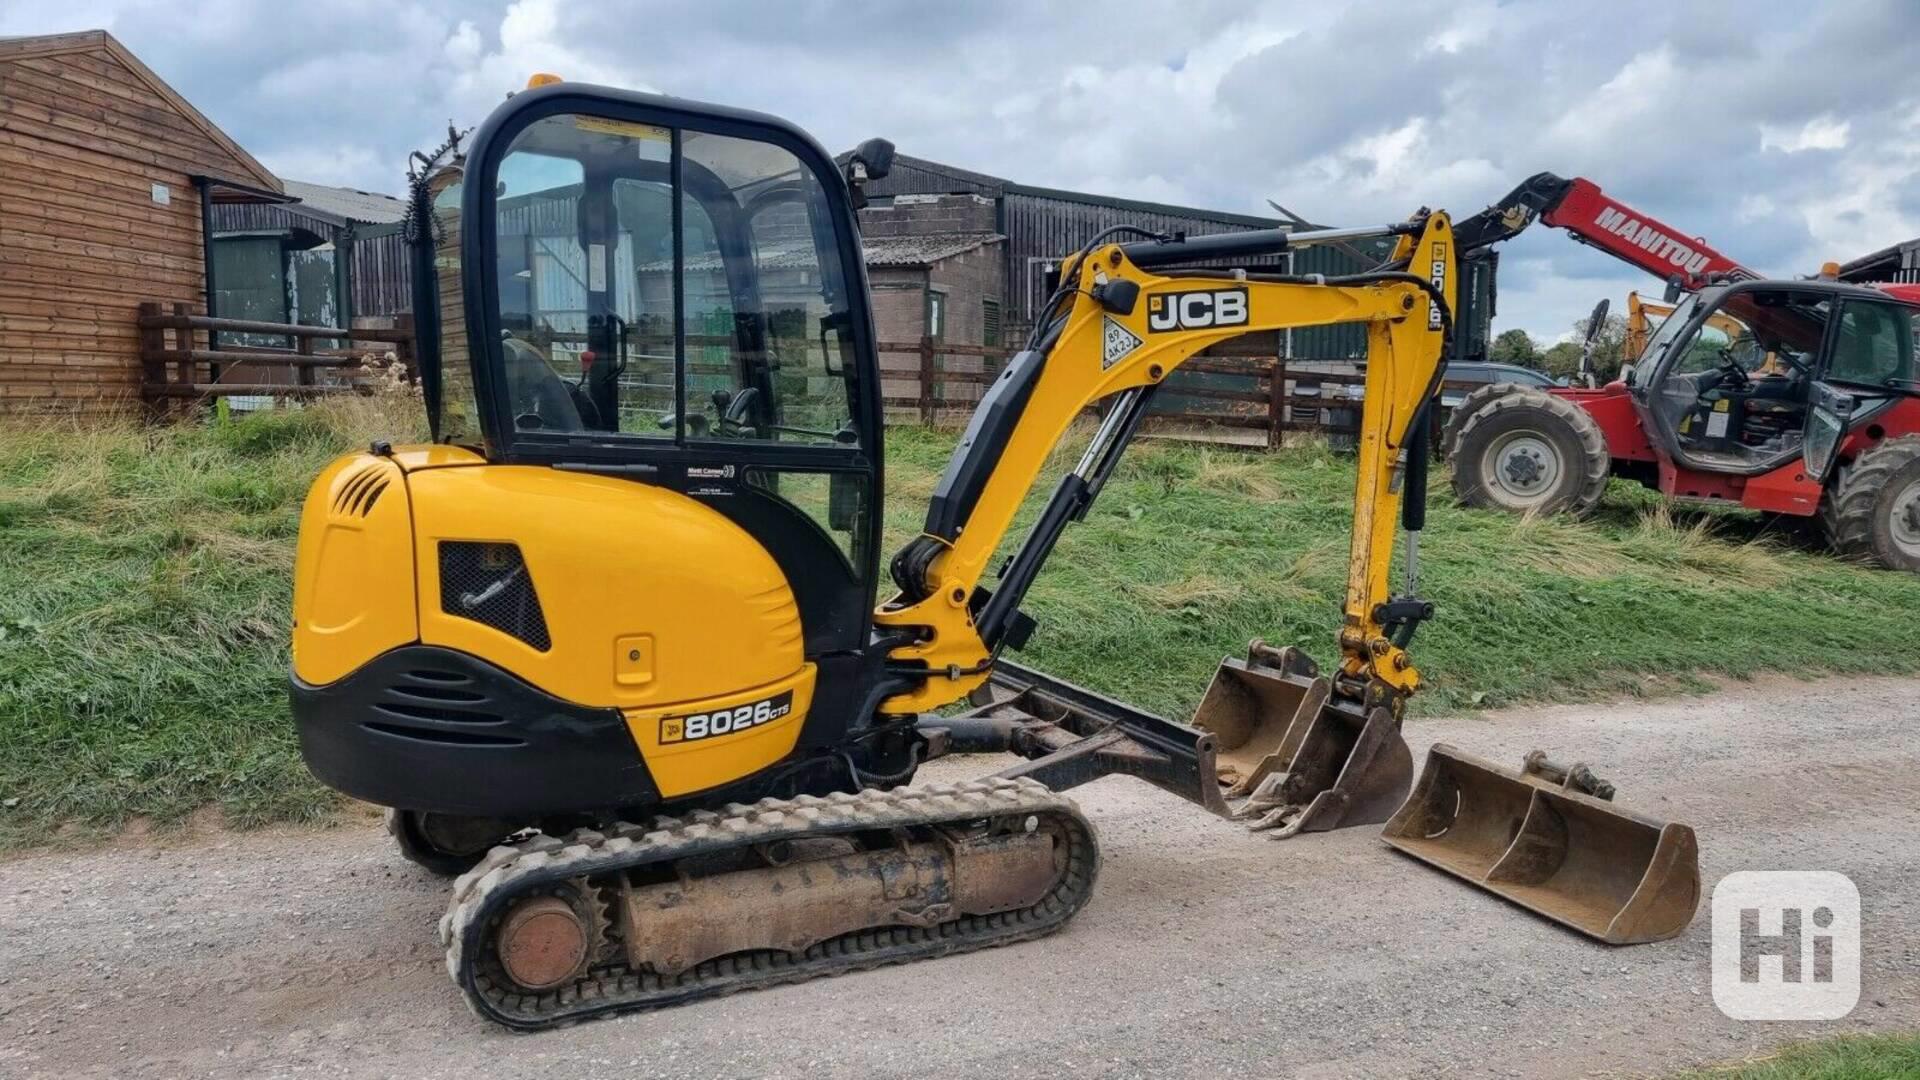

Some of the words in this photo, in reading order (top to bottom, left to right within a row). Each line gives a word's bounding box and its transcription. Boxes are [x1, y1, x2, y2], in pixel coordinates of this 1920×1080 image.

[1594, 206, 1712, 274] MANITOU
[1150, 291, 1248, 330] JCB
[1108, 329, 1120, 343] 89
